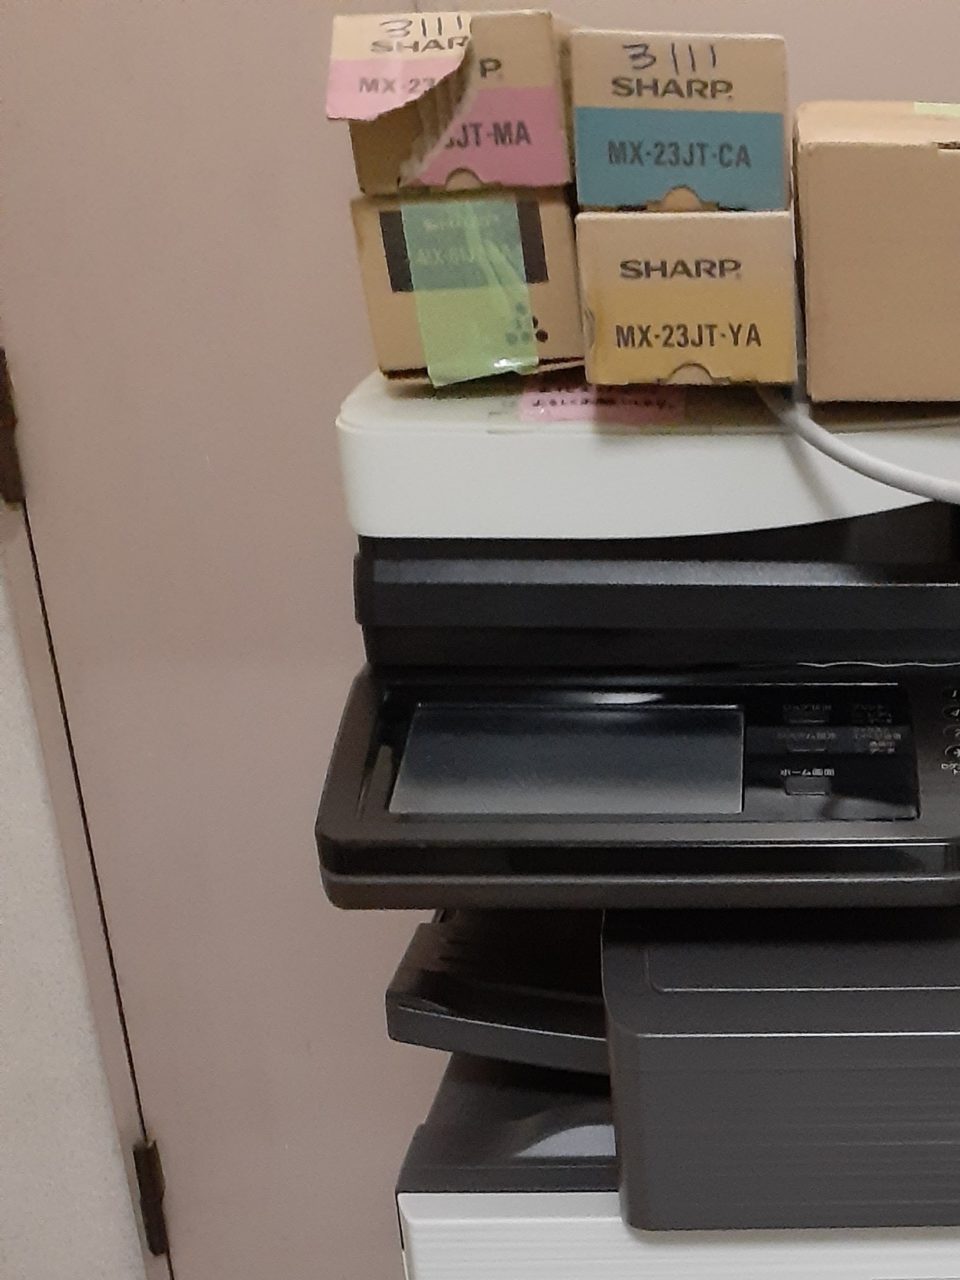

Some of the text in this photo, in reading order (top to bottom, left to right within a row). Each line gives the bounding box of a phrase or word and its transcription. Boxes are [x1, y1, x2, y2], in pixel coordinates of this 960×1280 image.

[378, 15, 464, 38] 3111
[623, 42, 717, 75] 3111
[612, 77, 734, 99] SHARP
[444, 120, 532, 149] JT-MA
[608, 139, 752, 169] MX-23JT-CA
[619, 259, 742, 280] SHARP
[615, 323, 762, 348] MX-23JT-YA
